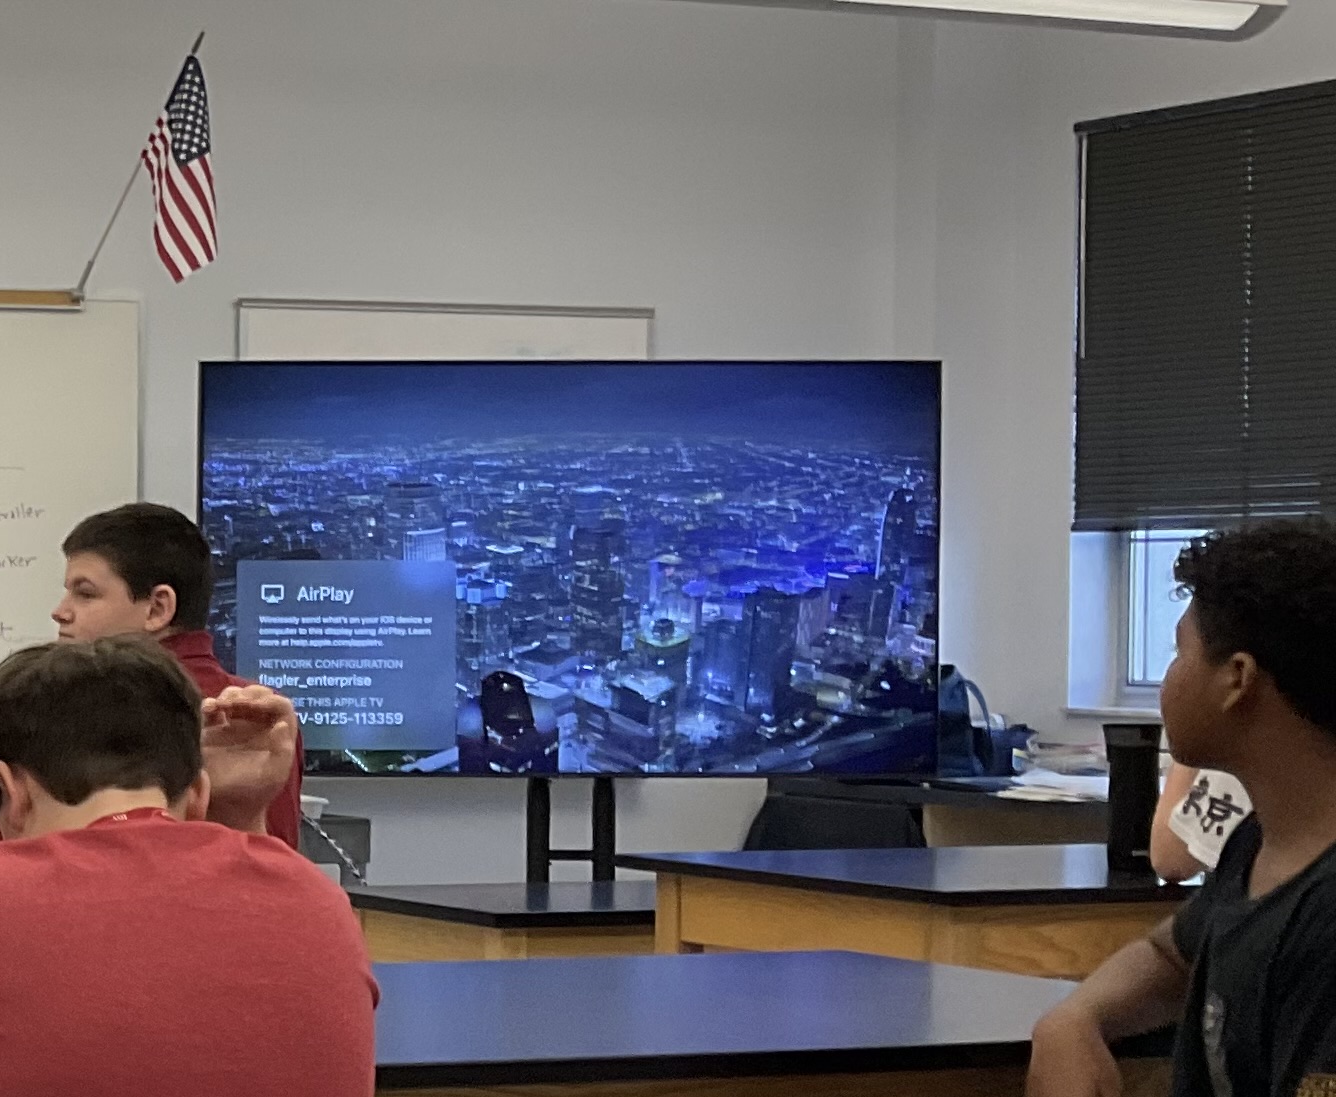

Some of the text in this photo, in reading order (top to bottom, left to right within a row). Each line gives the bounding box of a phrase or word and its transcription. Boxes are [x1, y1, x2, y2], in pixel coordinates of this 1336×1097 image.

[297, 585, 355, 604] AirPlay
[258, 659, 404, 669] NETWORK CONFIGURATION
[258, 674, 373, 689] flagler_enterprise
[307, 697, 332, 707] THIS
[333, 697, 368, 707] APPLE
[369, 697, 384, 707] TV
